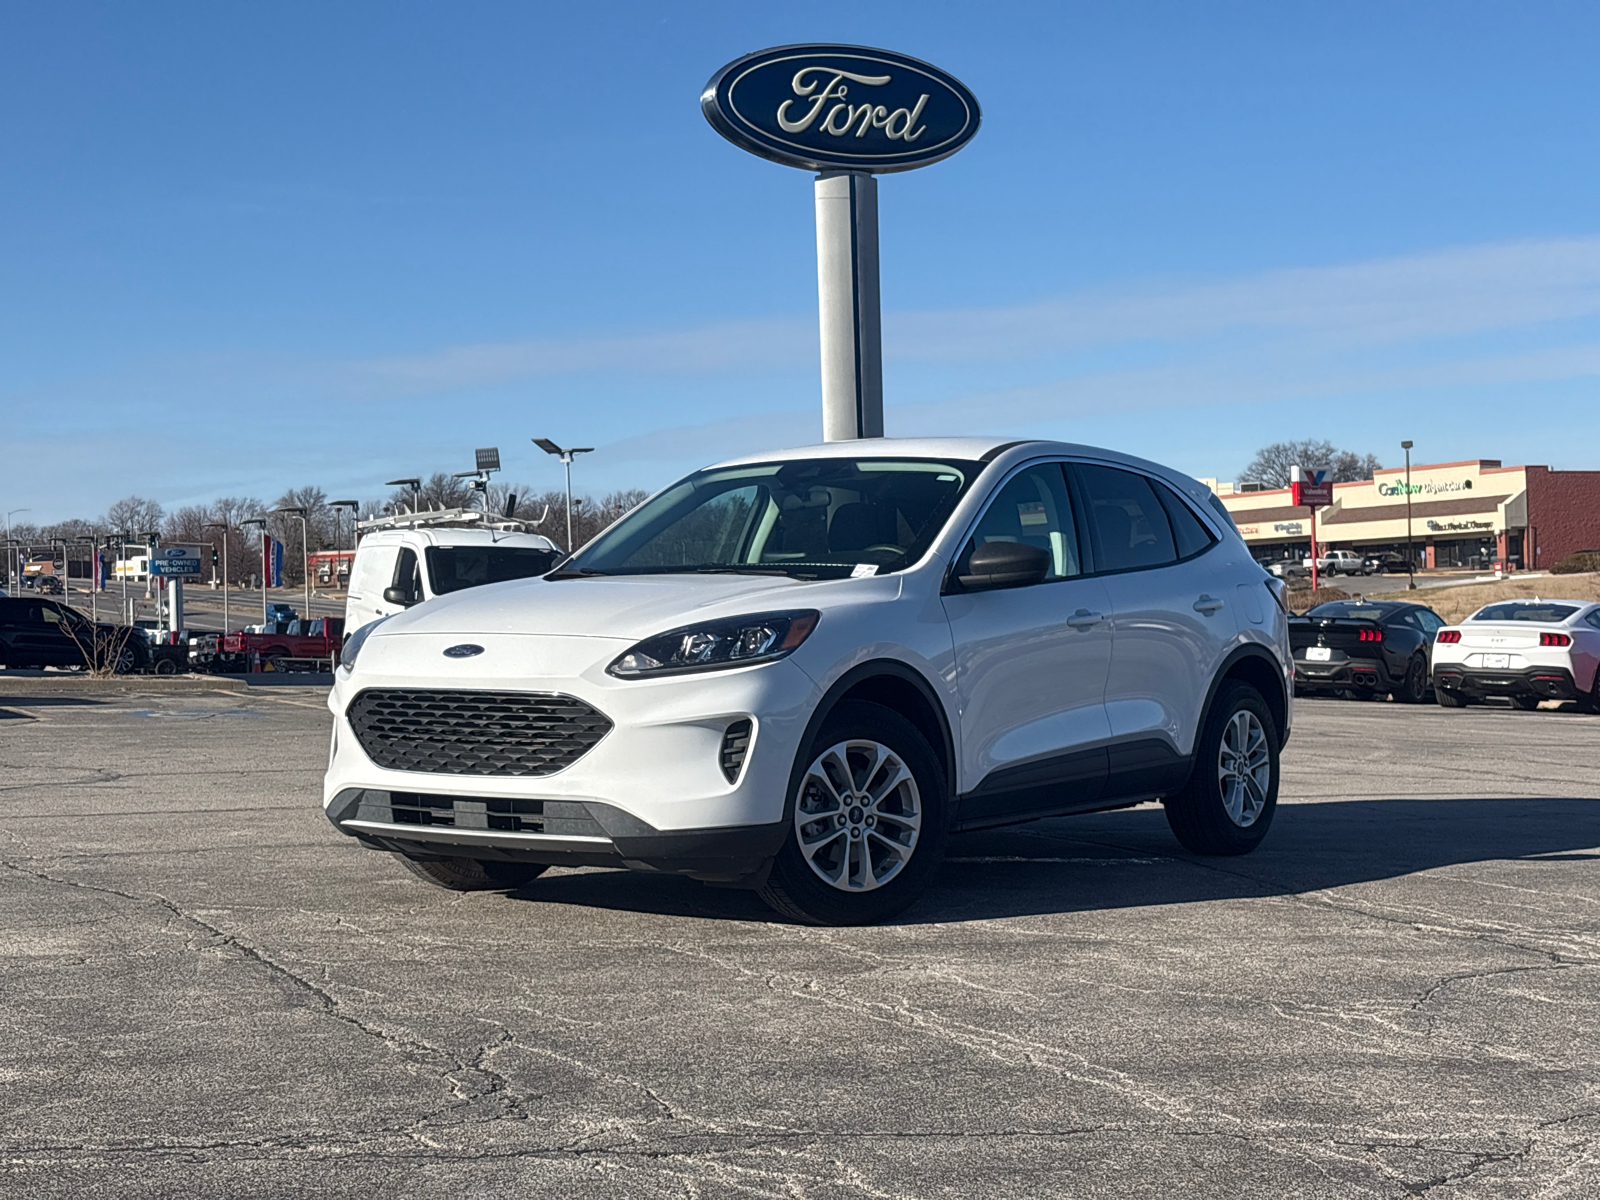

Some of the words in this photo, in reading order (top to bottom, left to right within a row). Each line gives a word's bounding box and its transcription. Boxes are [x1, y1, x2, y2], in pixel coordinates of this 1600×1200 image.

[777, 66, 930, 142] Ford
[1303, 488, 1328, 496] Valvoline
[169, 549, 184, 557] Ford
